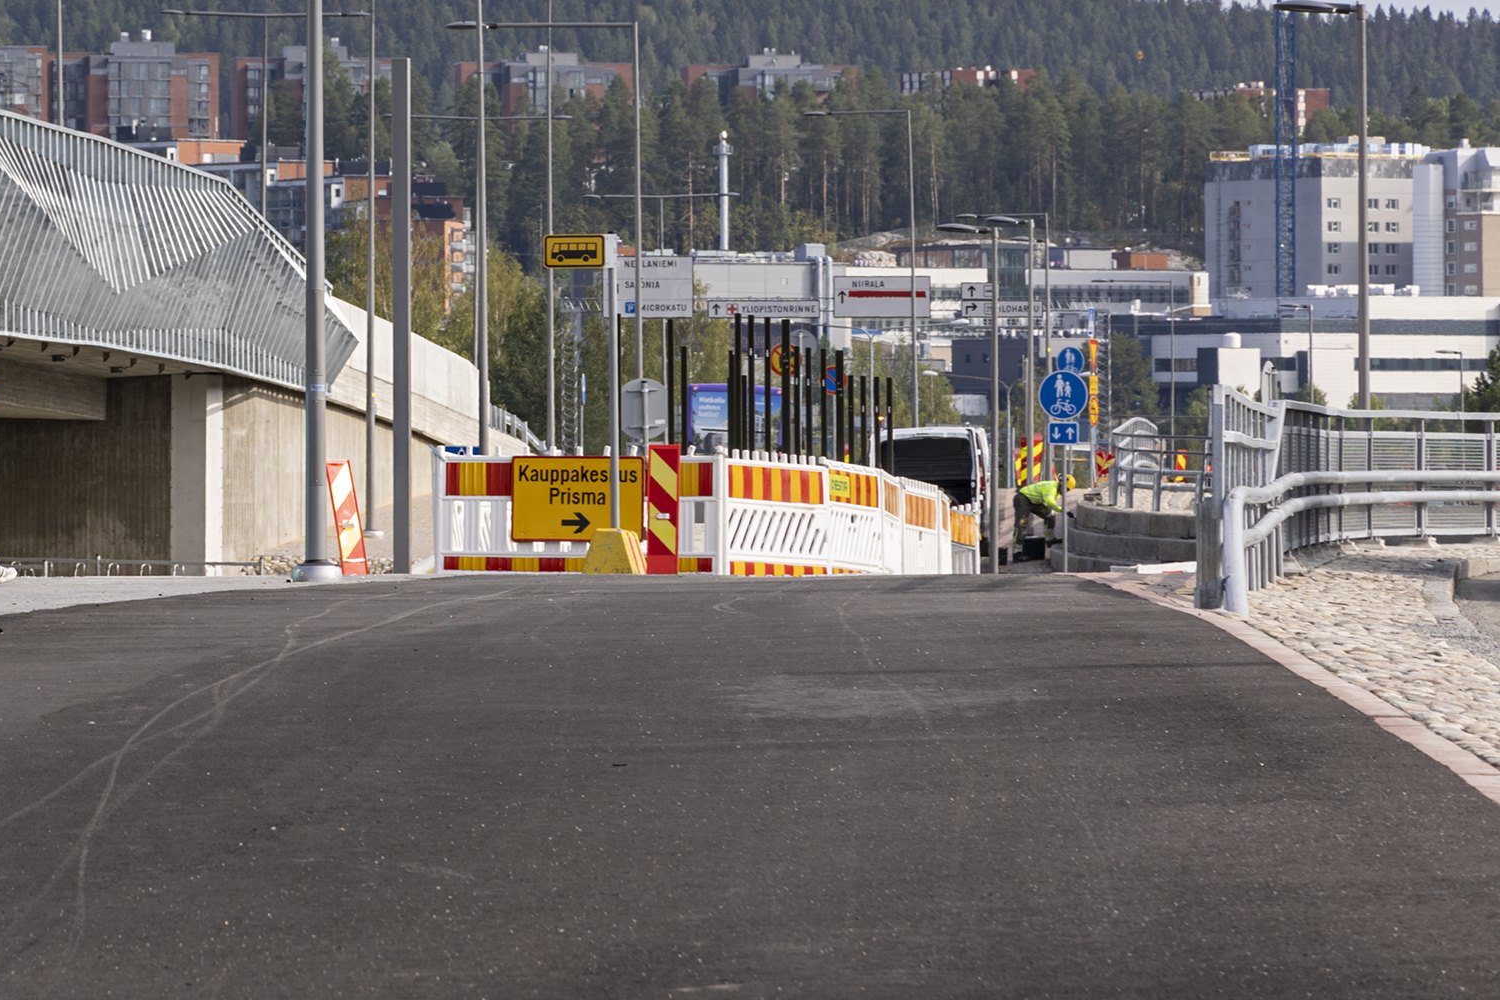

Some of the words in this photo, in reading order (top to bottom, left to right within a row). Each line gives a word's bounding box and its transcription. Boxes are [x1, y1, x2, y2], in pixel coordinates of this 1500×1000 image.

[624, 260, 678, 268] NELANIEMI
[852, 280, 885, 288] NIIRALA
[742, 304, 816, 313] YLIOPISTONRINNE
[999, 305, 1039, 313] ILOHARU
[518, 465, 638, 486] Kauppakesus
[549, 488, 606, 505] Prisma
